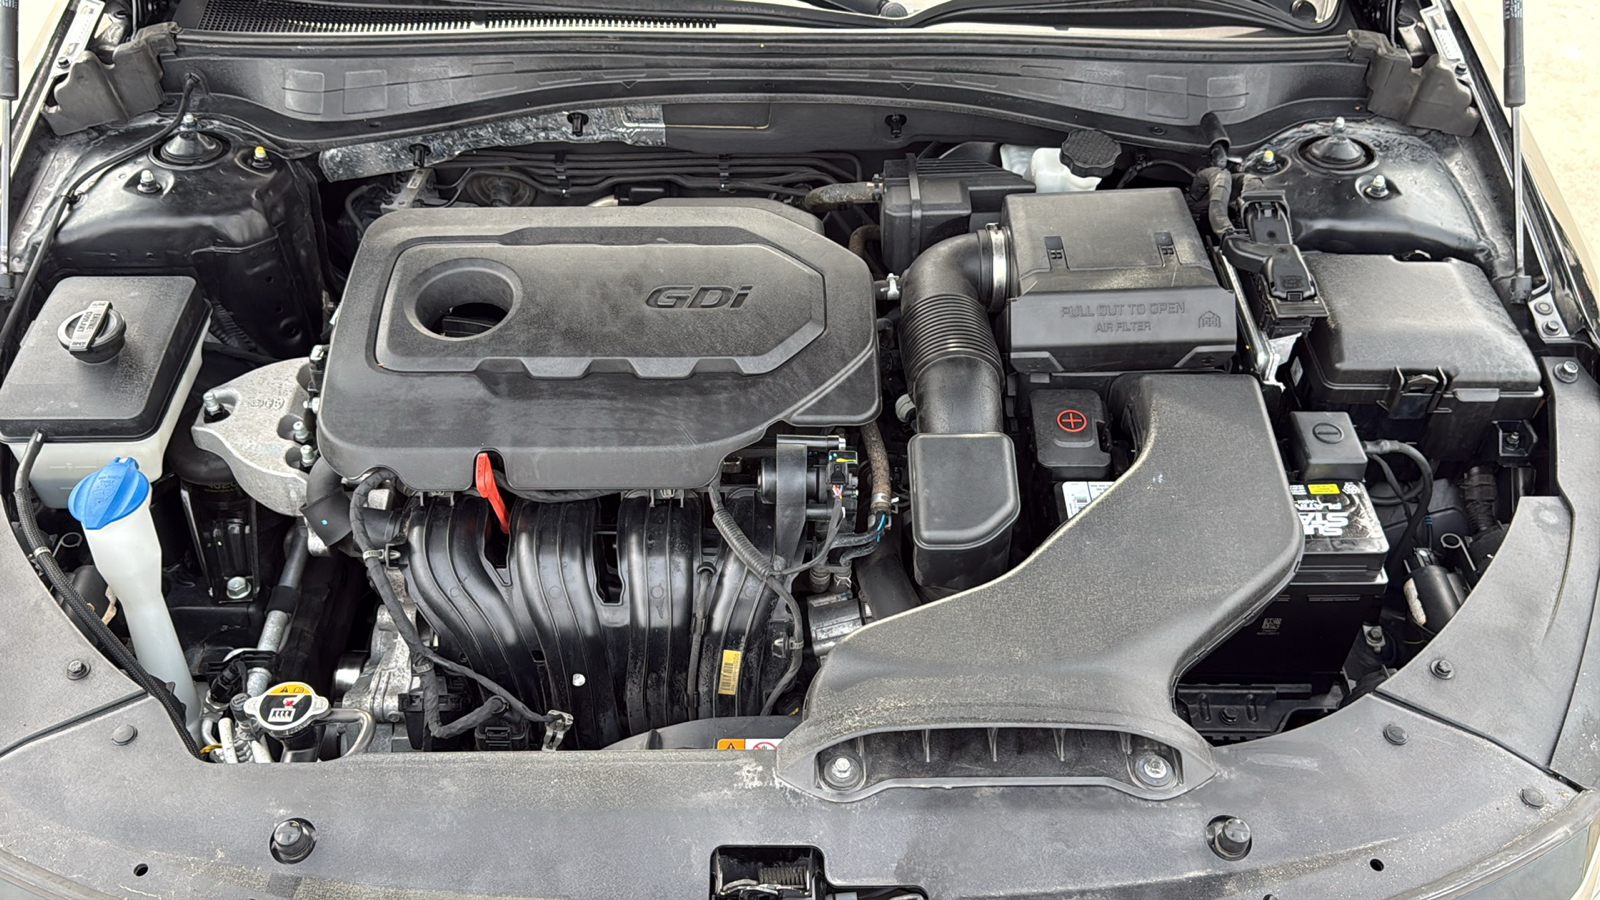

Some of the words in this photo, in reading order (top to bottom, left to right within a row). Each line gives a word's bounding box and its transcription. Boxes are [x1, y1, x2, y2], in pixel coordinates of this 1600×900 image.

[645, 285, 753, 309] GDi
[1061, 305, 1095, 318] PULL
[1096, 304, 1125, 316] OUT
[1128, 303, 1145, 315] TO
[1149, 302, 1186, 315] OPEN
[1095, 322, 1113, 333] AIR
[1115, 321, 1151, 332] FILTER
[1294, 502, 1342, 510] PLATIN
[1297, 512, 1349, 527] STA
[1303, 524, 1343, 536] SU
